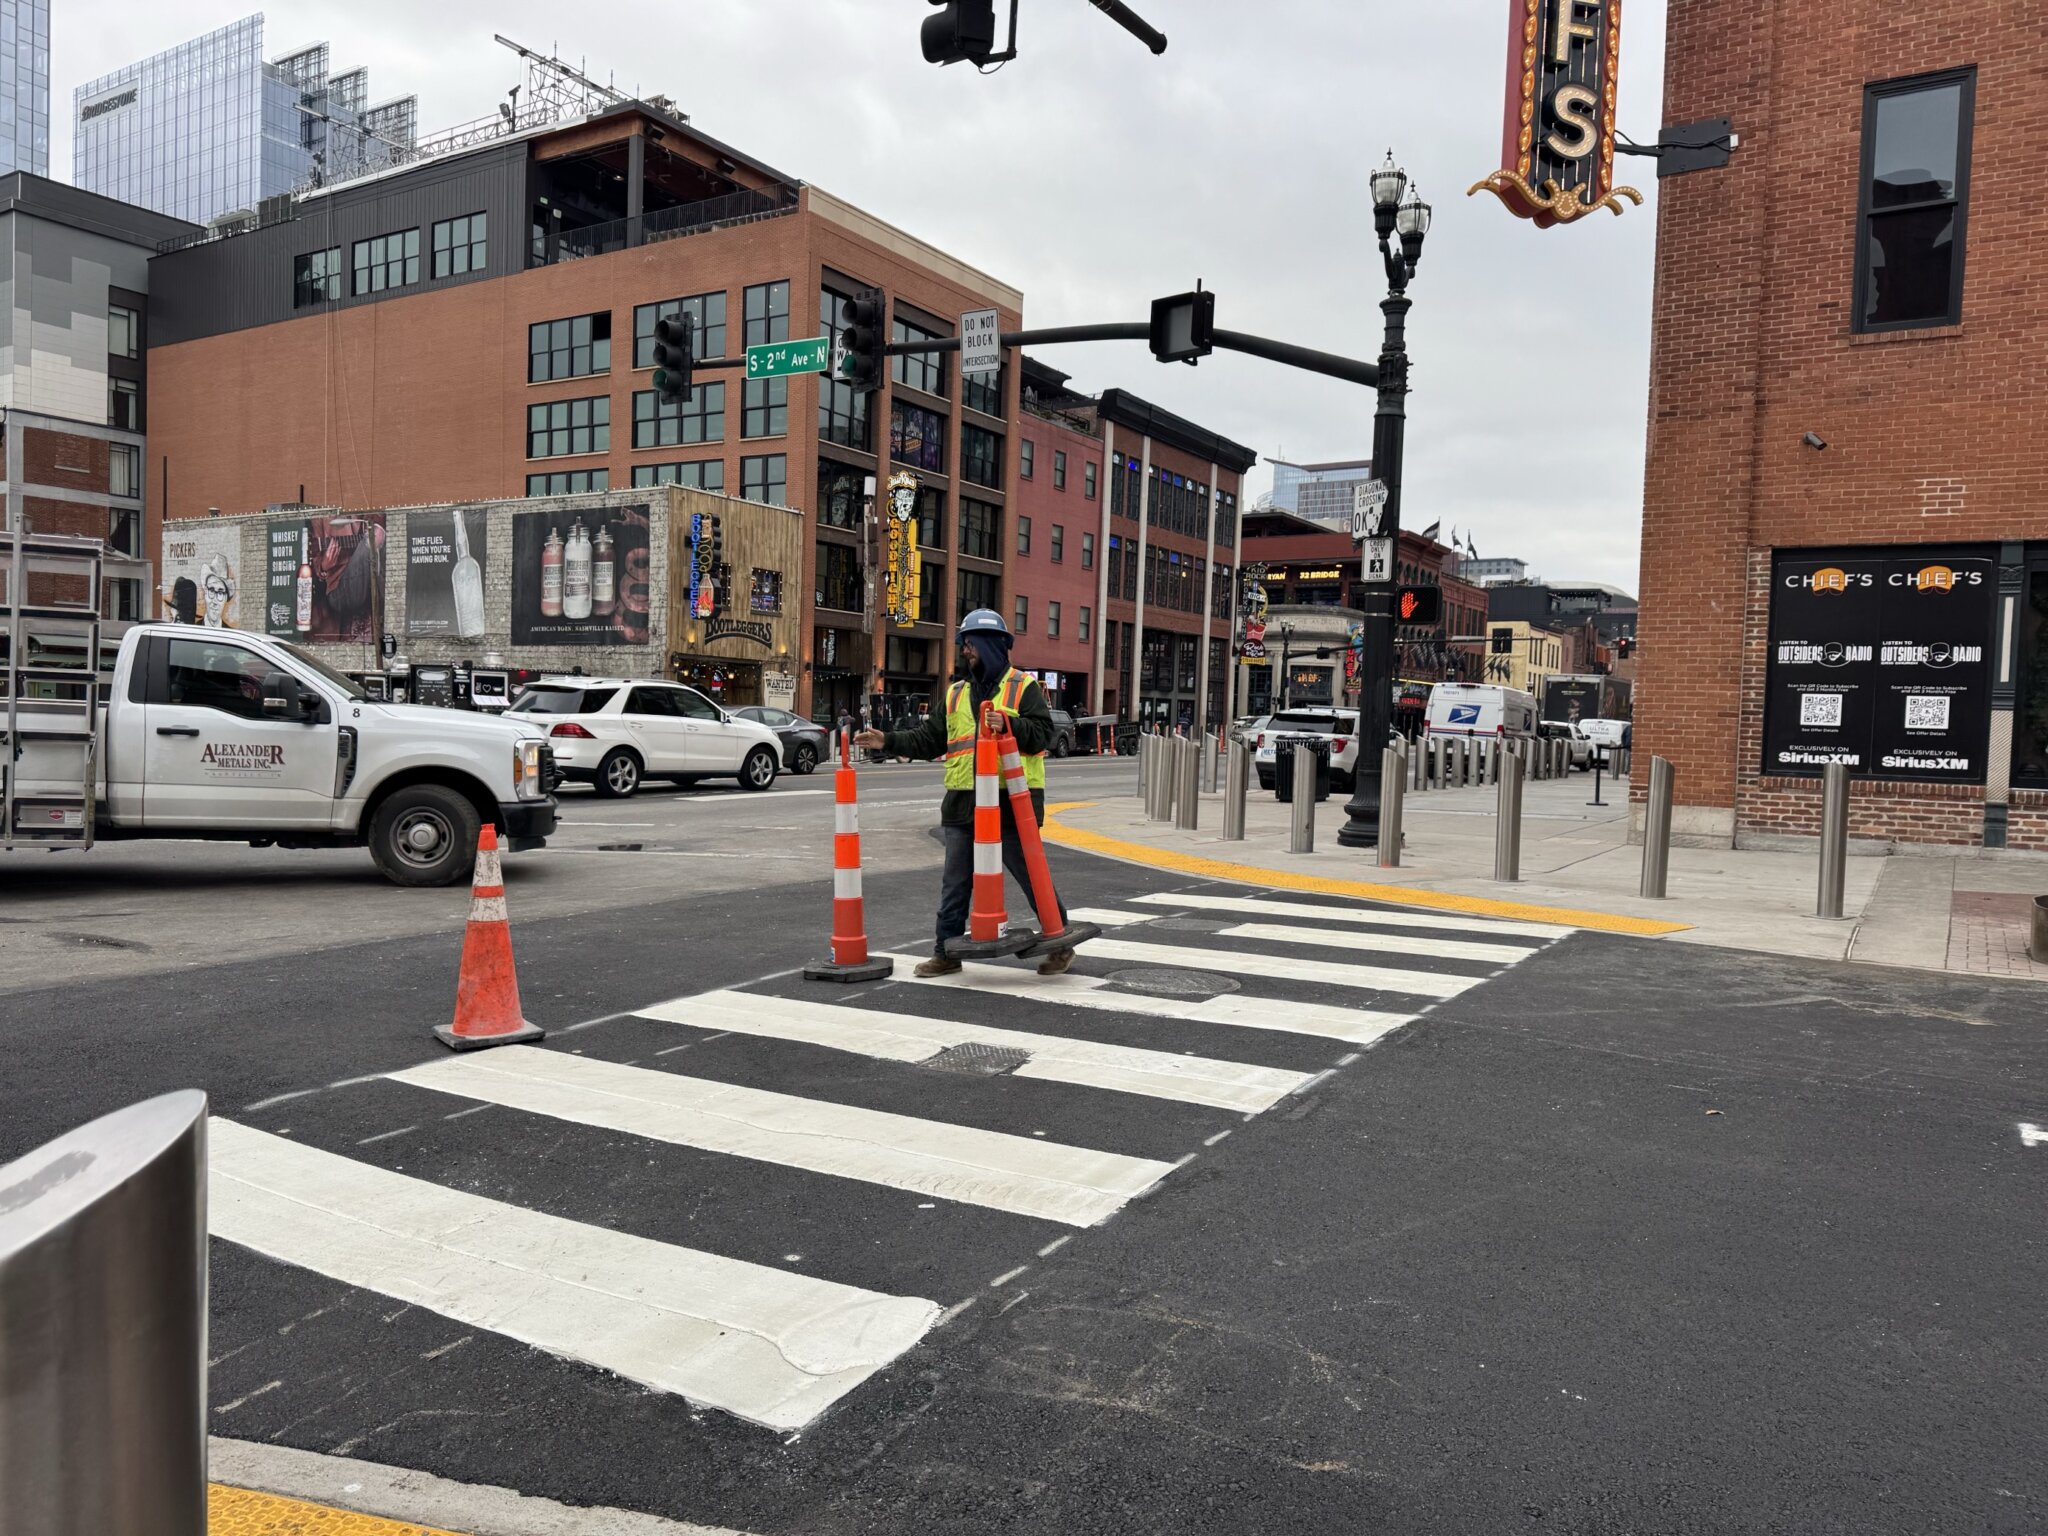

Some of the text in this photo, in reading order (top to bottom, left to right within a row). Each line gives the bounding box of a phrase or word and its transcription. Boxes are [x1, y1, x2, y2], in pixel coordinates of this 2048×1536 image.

[81, 87, 137, 121] BRIDGESTONE
[965, 315, 995, 330] DO NOT
[967, 335, 993, 348] BLOCK
[962, 354, 998, 367] INTERSECTION
[1359, 482, 1386, 496] DIAGONAL
[1359, 492, 1385, 507] CROSSING
[1354, 511, 1368, 532] OK
[272, 530, 298, 543] WHISKEY
[412, 536, 443, 545] TIME FLIES
[169, 542, 196, 558] PICKERS
[272, 546, 293, 557] WORTH
[412, 545, 451, 555] WHEN YOU'RE
[272, 560, 296, 572] SINGING
[412, 555, 433, 564] HAVING
[272, 575, 291, 586] ABOUT
[1267, 571, 1286, 580] RYAN
[1310, 571, 1340, 579] BRIDGE
[1785, 573, 1873, 588] CHIEF'S
[1888, 571, 1982, 587] CHIEF'S
[705, 619, 772, 642] BOOTLEGGERS
[1778, 646, 1873, 661] OUTSIDERS RADIO
[1881, 646, 1982, 662] OUTSIDERS RADIO
[766, 678, 793, 689] WANTED
[353, 708, 361, 717] 8
[200, 743, 285, 765] ALEXANDER
[1778, 751, 1860, 765] SiriusXM
[1893, 748, 1943, 756] EXCLUSIVELY
[217, 758, 271, 769] METALS INC.
[1881, 755, 1969, 770] SiriusXM
